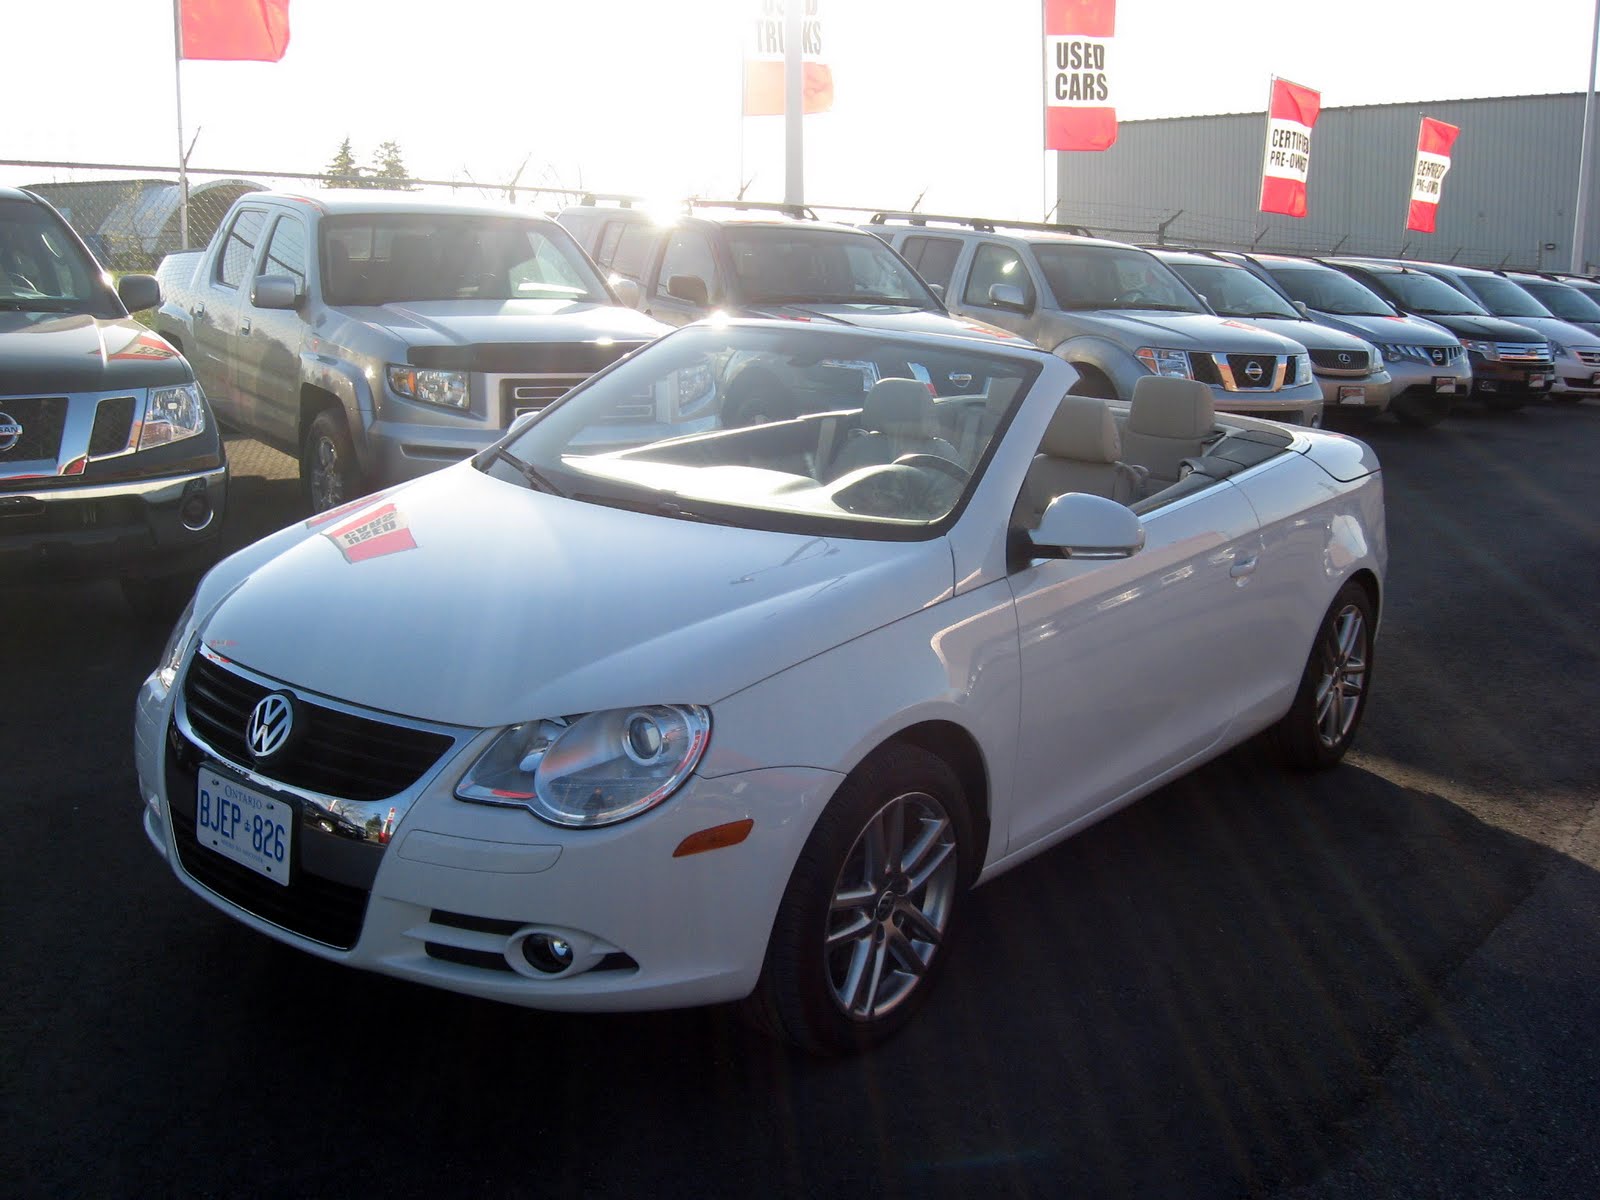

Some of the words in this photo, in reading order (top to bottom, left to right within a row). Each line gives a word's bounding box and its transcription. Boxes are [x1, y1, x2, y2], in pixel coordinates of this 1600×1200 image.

[755, 20, 822, 55] TRUKS
[1056, 41, 1105, 70] USED
[1055, 72, 1108, 101] CARS
[224, 784, 263, 810] ONTARIO
[200, 789, 241, 840] BJEP
[252, 814, 286, 863] 826
